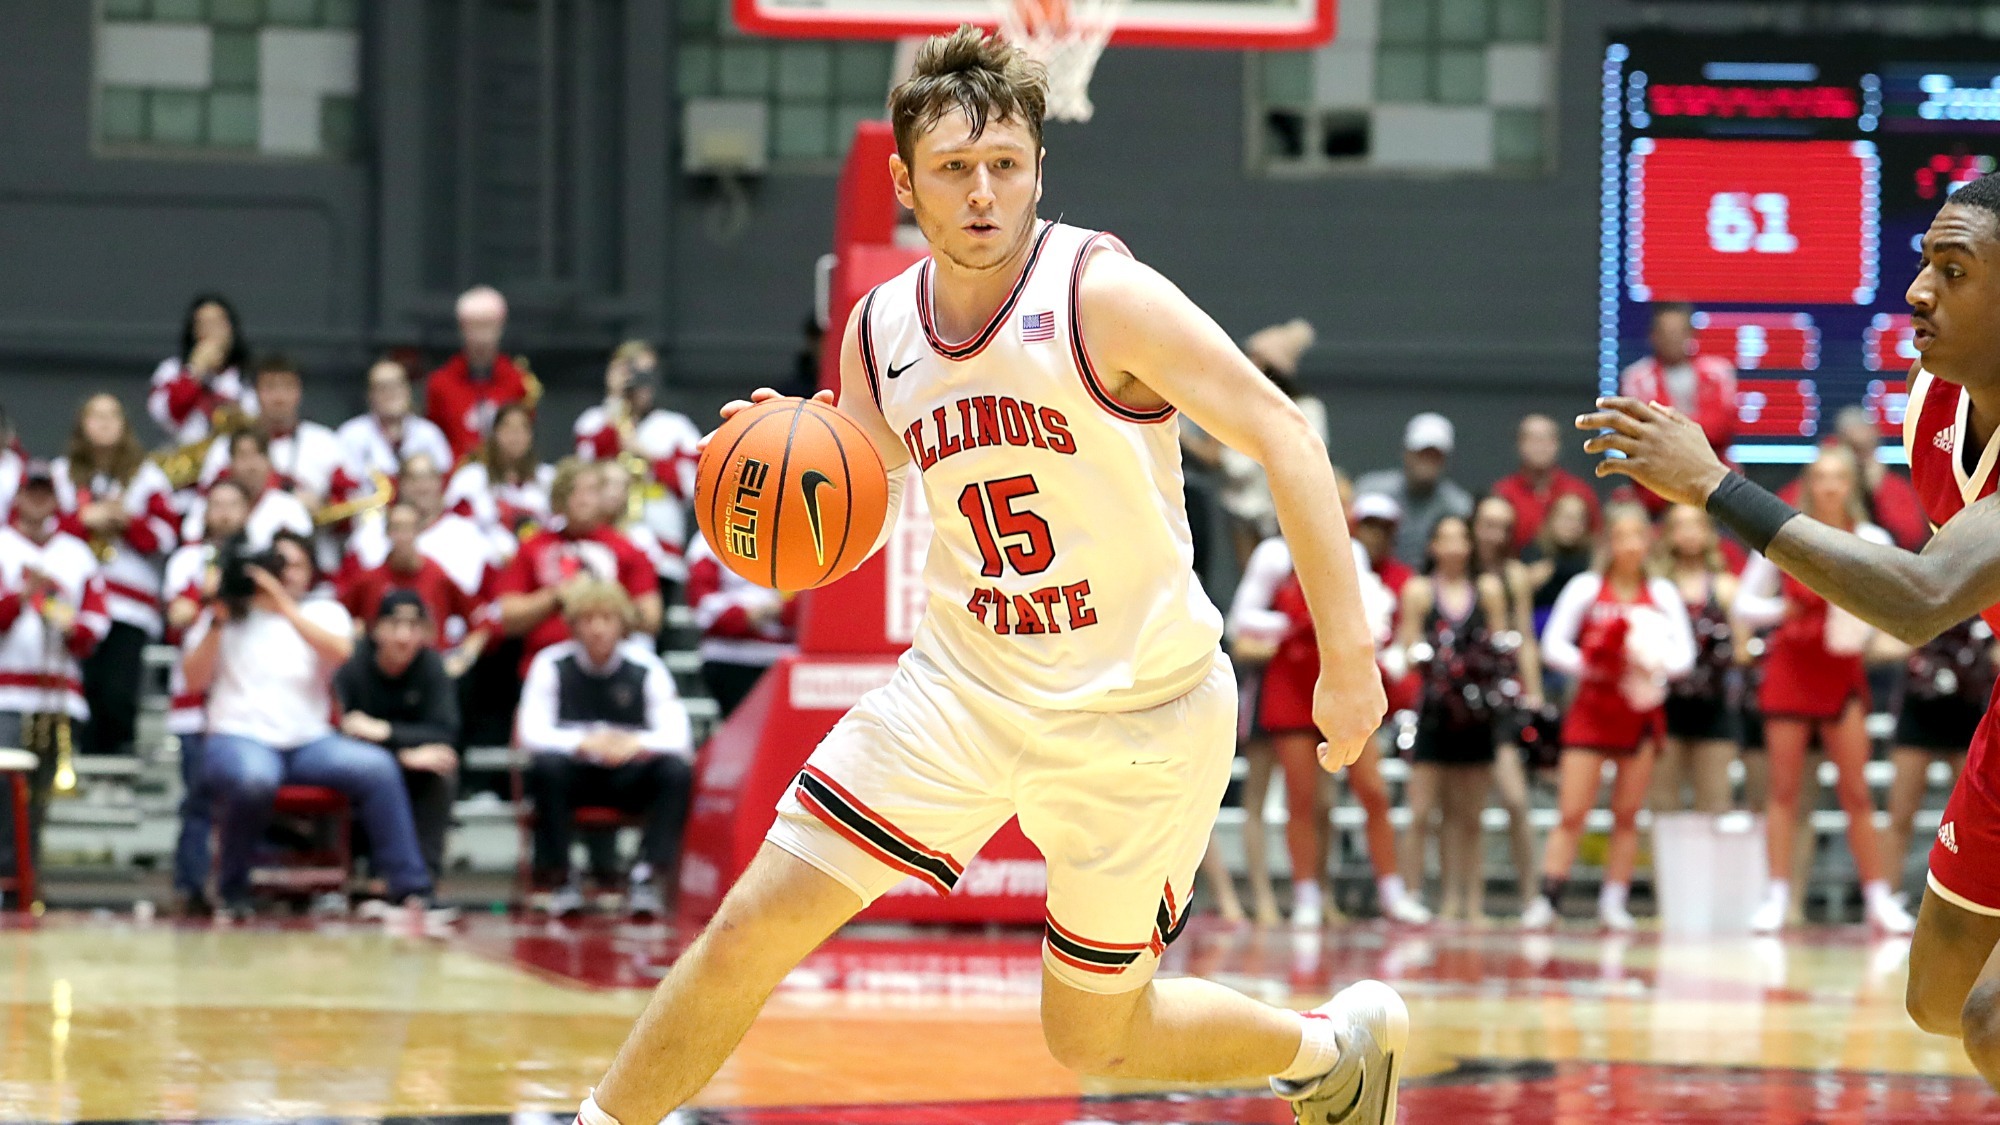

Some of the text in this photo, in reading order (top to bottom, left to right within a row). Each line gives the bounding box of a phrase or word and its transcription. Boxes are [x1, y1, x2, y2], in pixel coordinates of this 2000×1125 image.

[1706, 192, 1798, 253] 61
[904, 395, 1077, 473] ILLINOIS
[1933, 436, 1953, 454] adida
[732, 457, 770, 560] ELITE
[957, 473, 1056, 578] 15
[966, 578, 1098, 635] STATE
